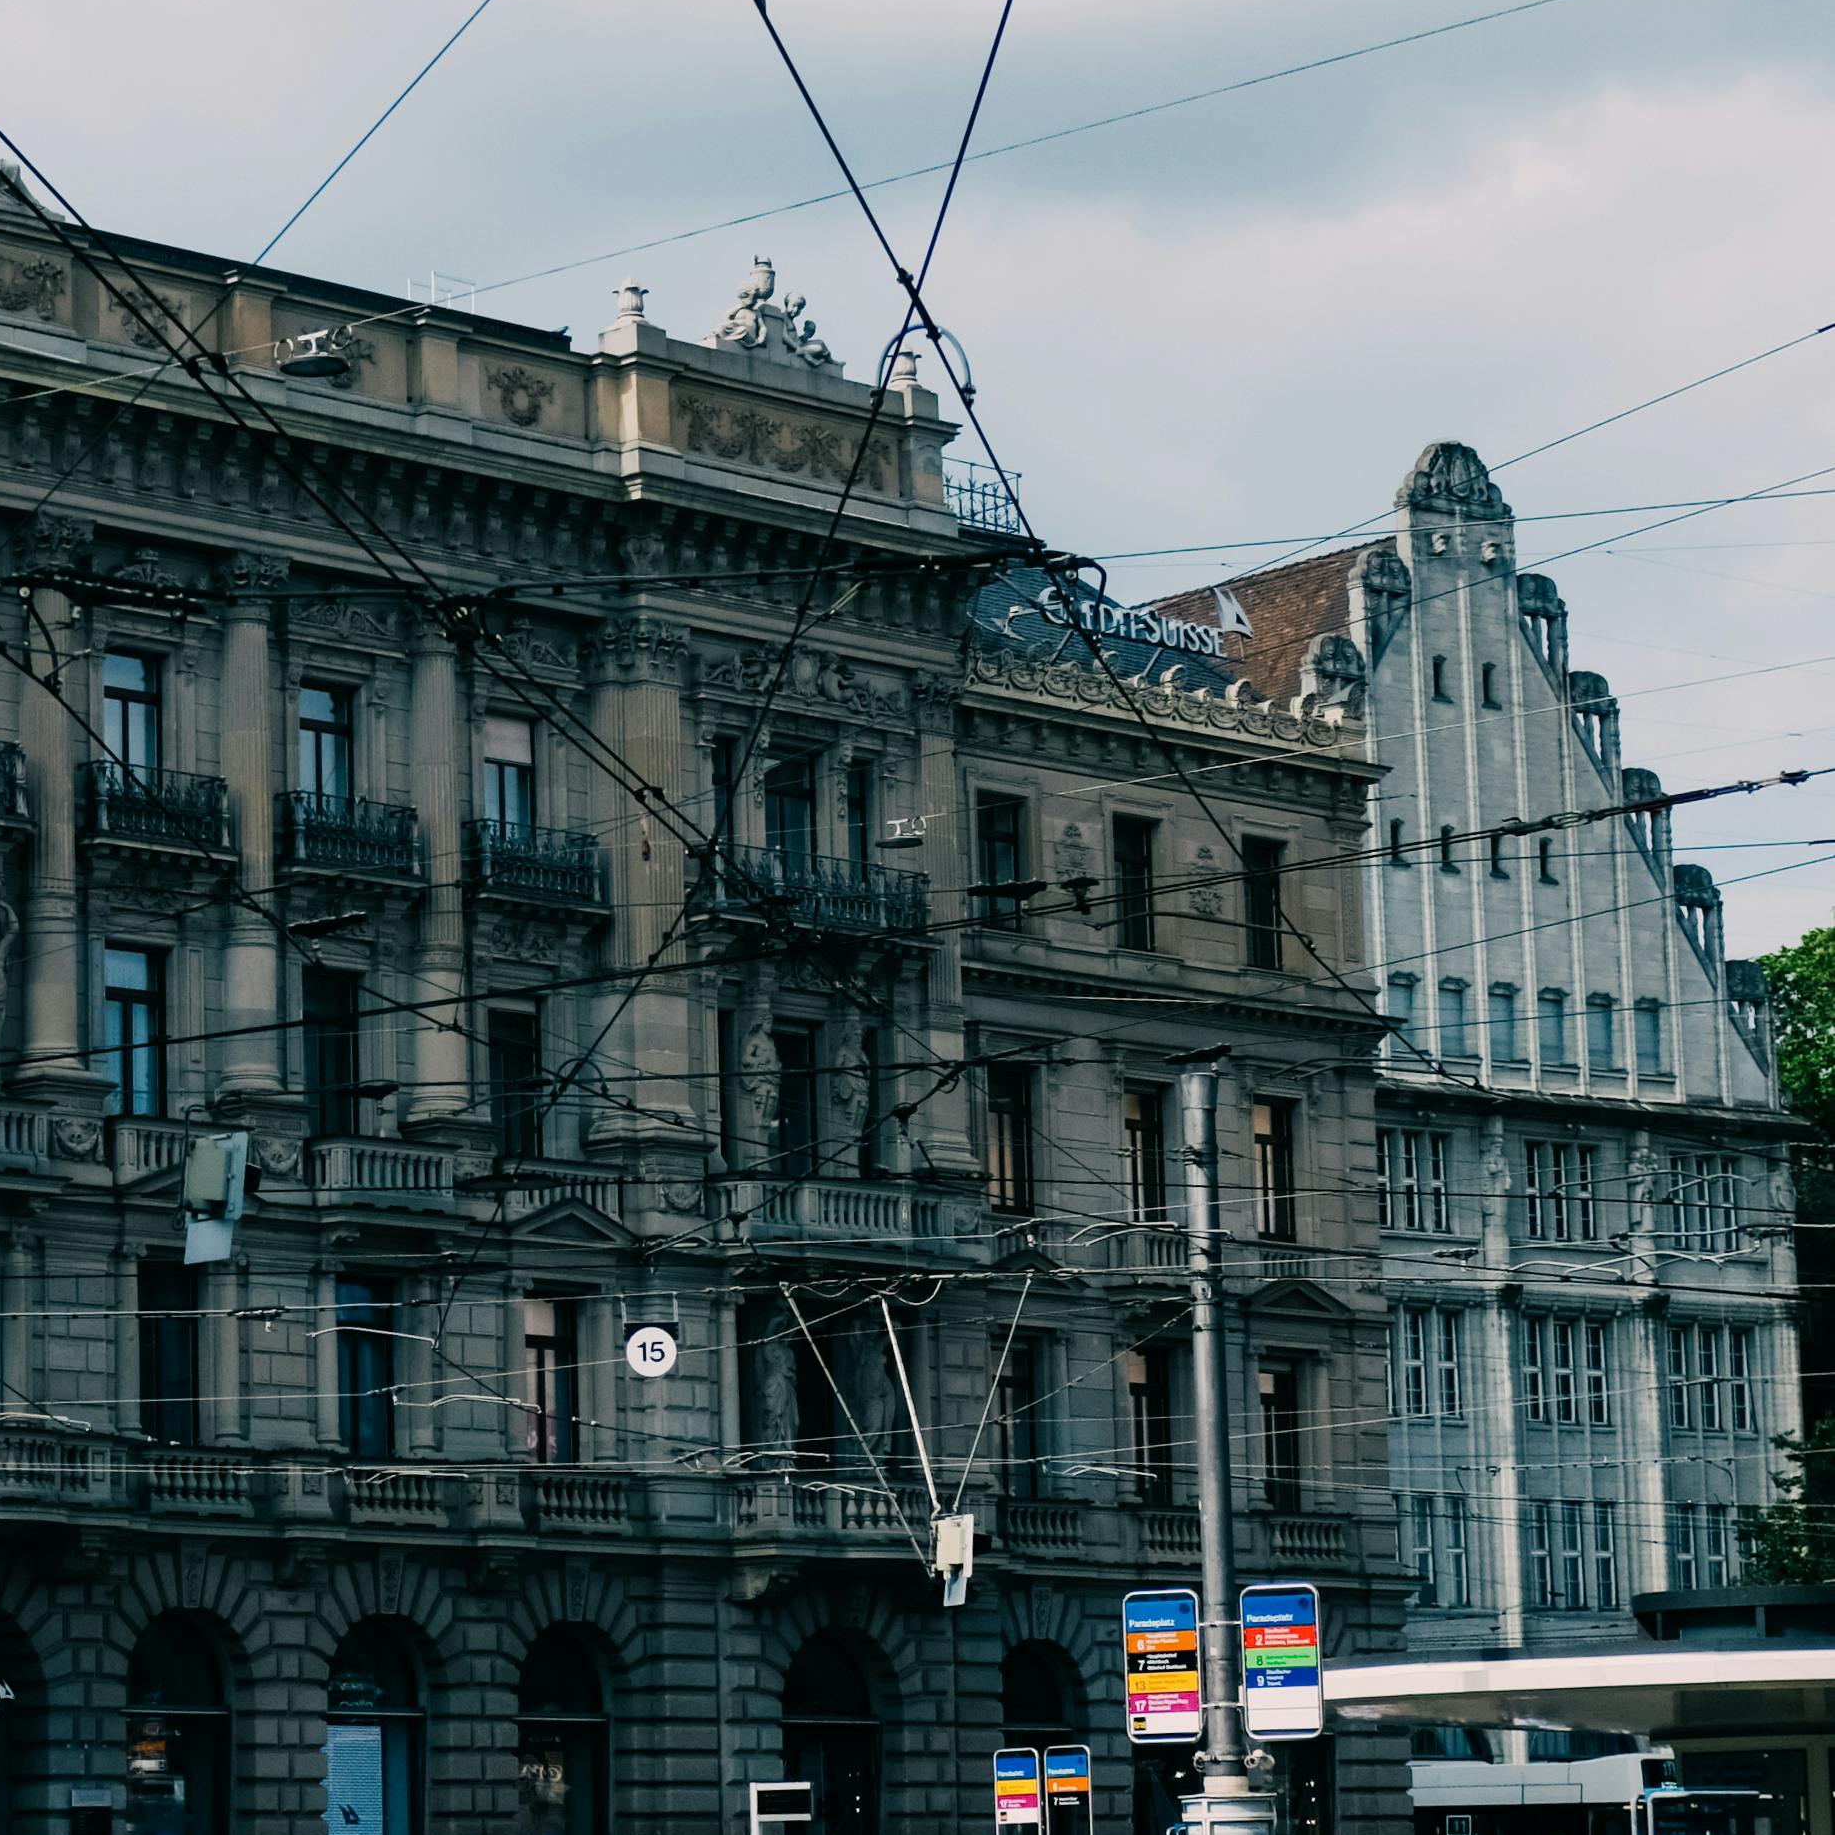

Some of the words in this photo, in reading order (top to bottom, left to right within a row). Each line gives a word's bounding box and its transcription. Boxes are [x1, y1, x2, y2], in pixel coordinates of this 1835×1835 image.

[1139, 606, 1226, 658] SUISSE
[637, 1341, 665, 1363] 15
[1255, 1634, 1263, 1646] 2
[1137, 1659, 1145, 1671] 7
[1256, 1655, 1263, 1666] 8
[1135, 1680, 1146, 1692] 13
[1256, 1675, 1264, 1687] 9
[1135, 1699, 1147, 1712] 17
